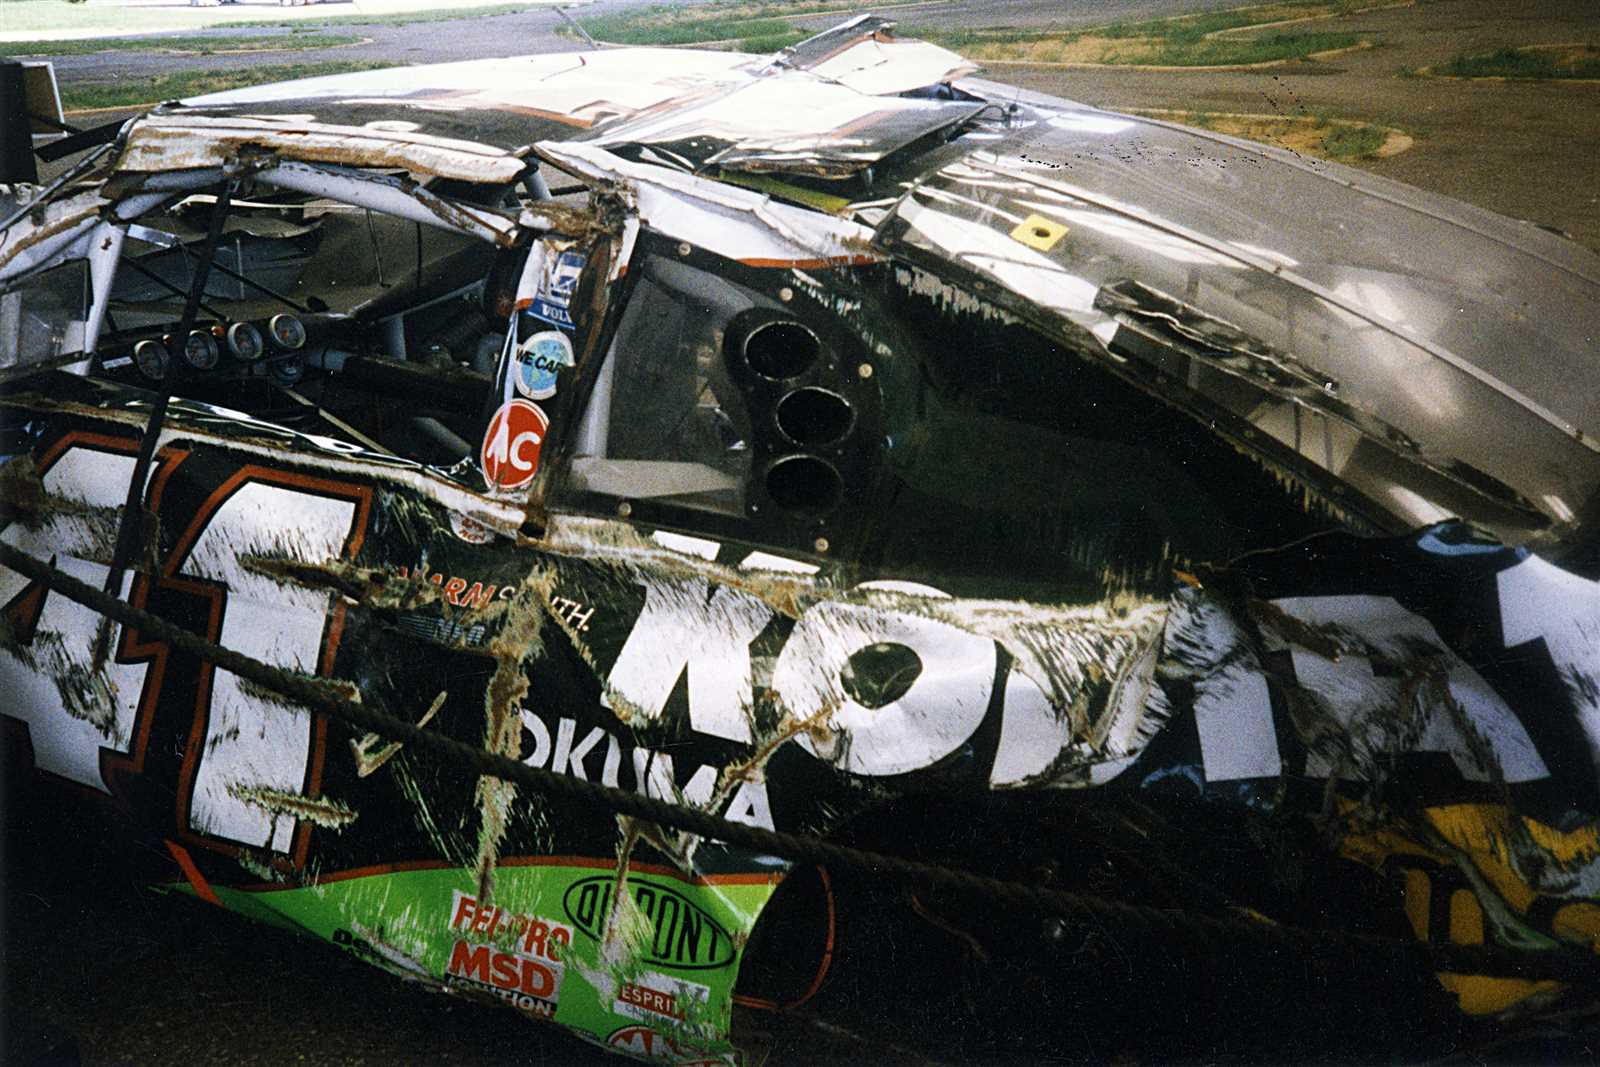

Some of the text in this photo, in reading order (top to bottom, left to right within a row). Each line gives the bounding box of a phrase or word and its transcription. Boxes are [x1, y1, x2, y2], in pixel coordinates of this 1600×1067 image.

[516, 348, 536, 366] WE
[486, 423, 542, 471] AC
[601, 531, 1600, 793] KODIA
[450, 940, 556, 998] MSD
